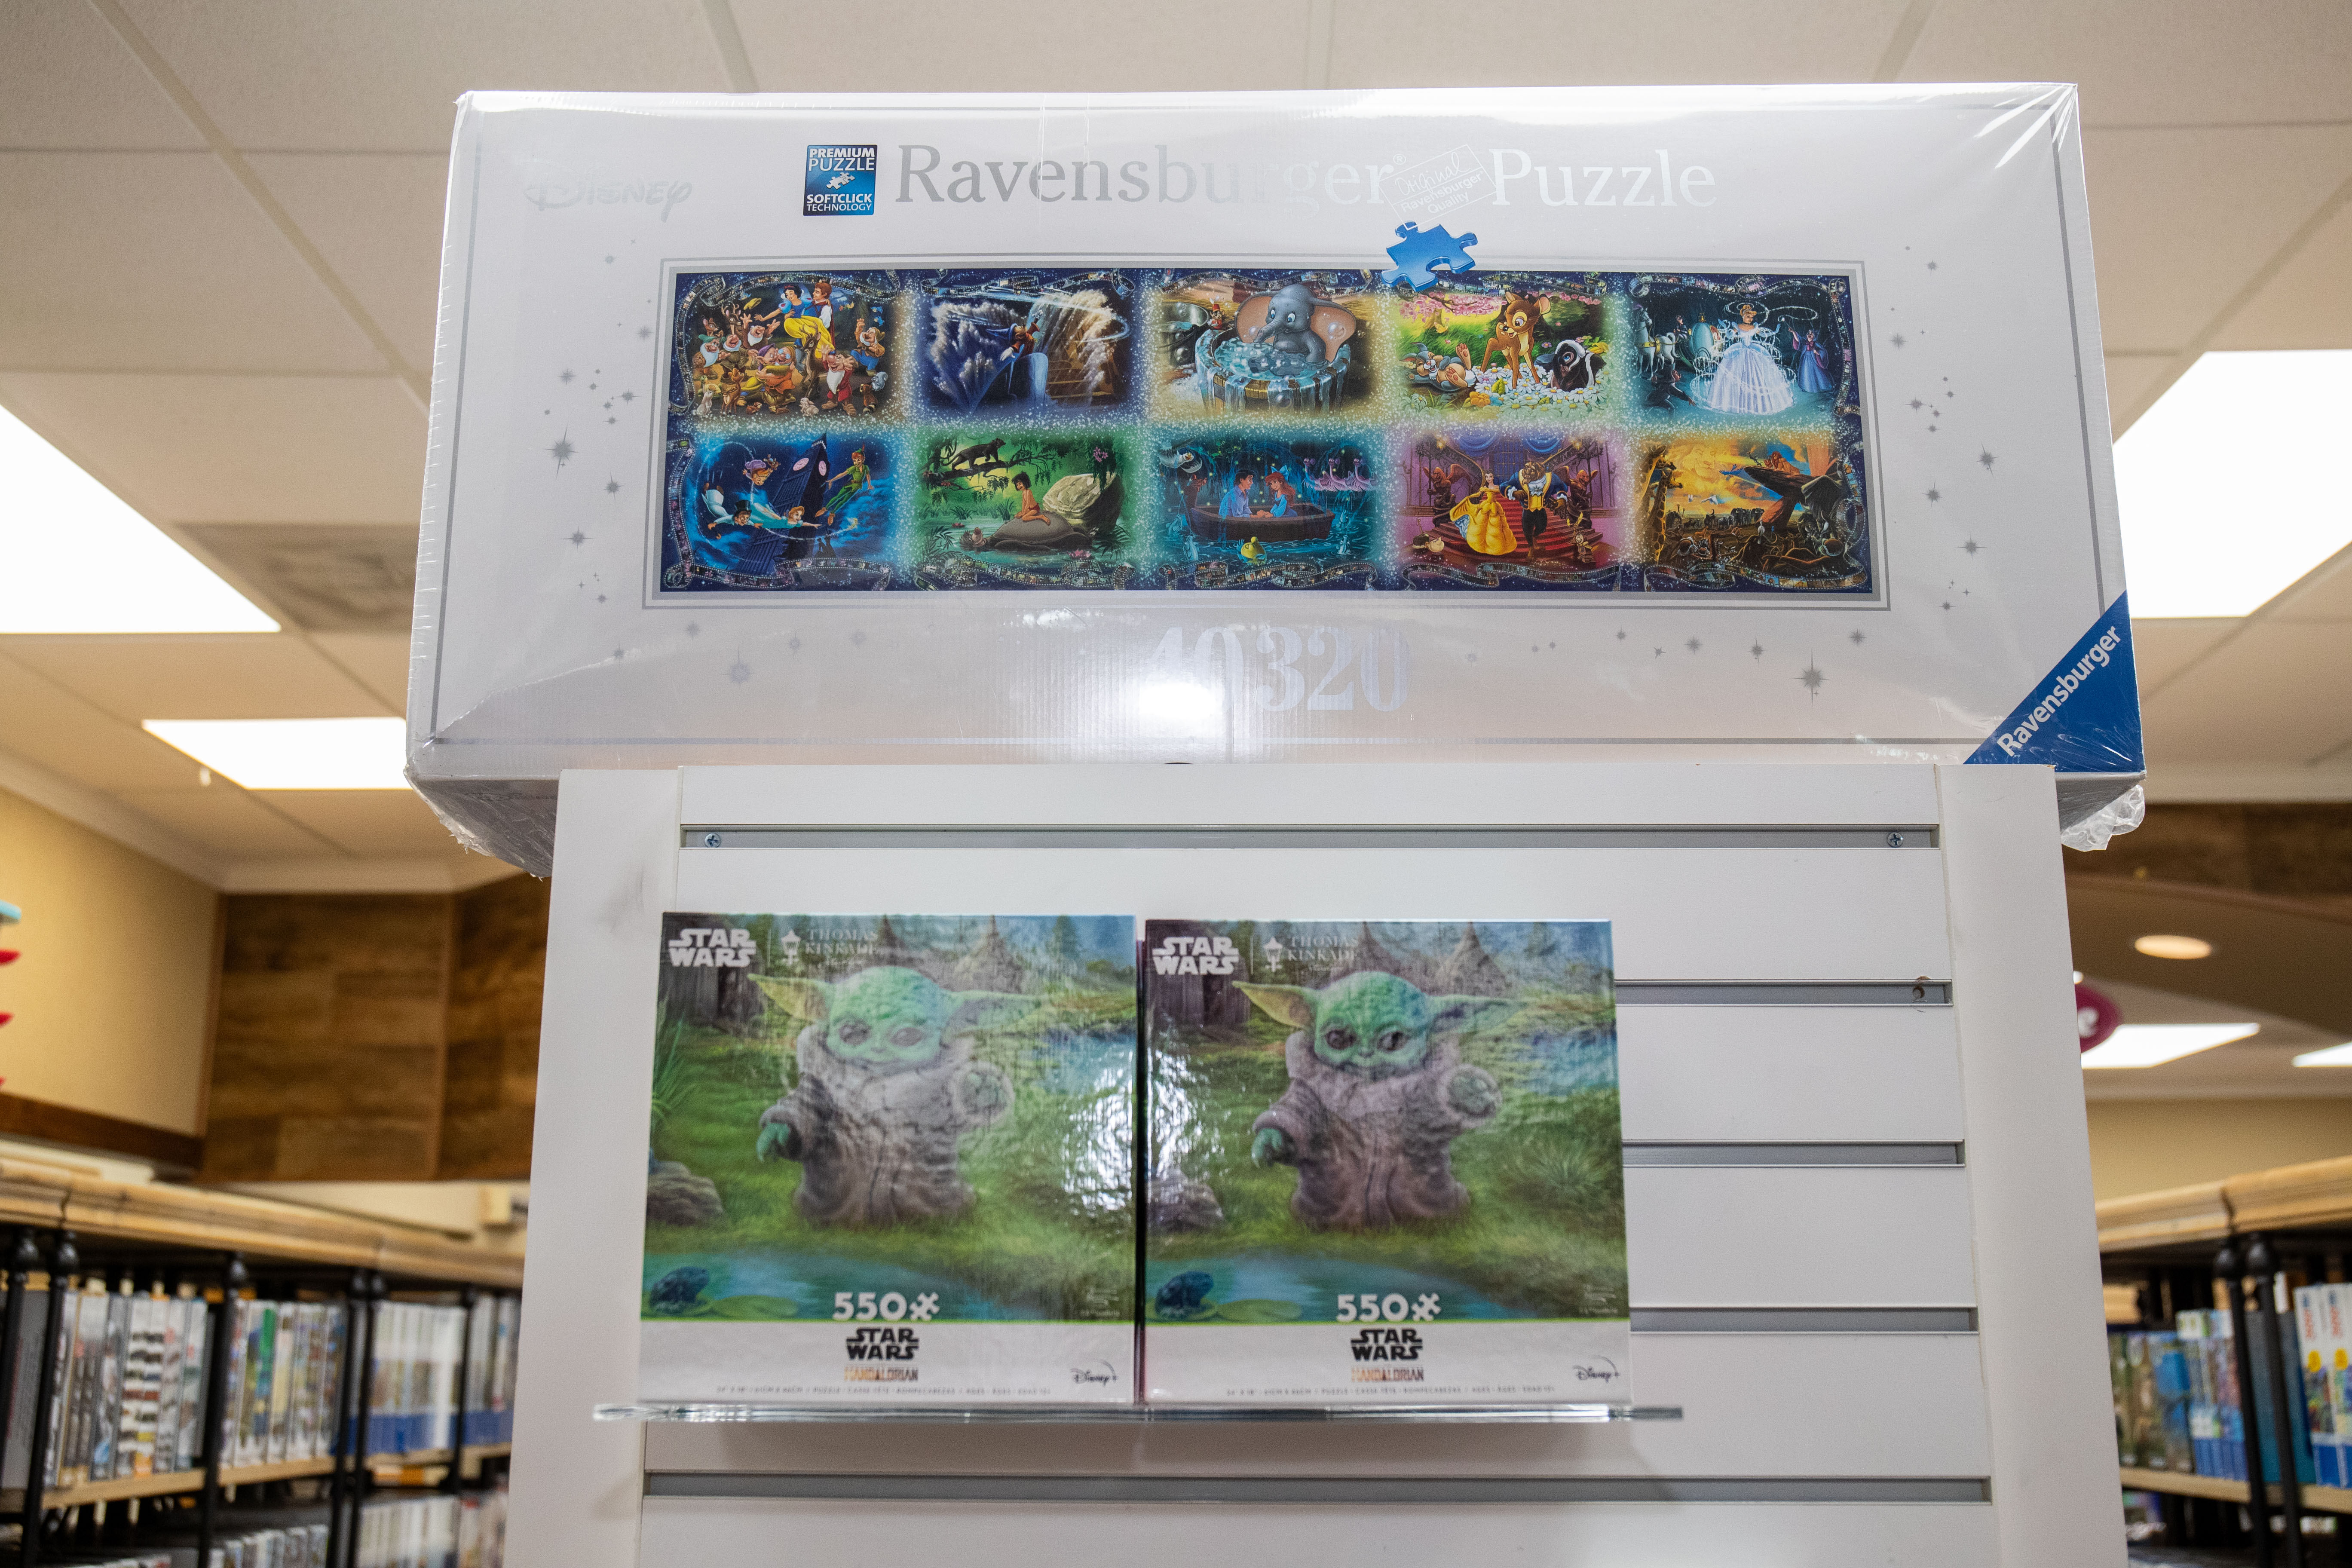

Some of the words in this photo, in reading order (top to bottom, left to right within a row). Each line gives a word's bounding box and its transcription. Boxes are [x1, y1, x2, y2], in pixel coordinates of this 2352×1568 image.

[810, 148, 875, 158] PREMIUM
[808, 157, 875, 171] PUZZLE
[1488, 149, 1718, 207] Puzzle
[806, 203, 872, 211] TECHNOLOGY
[807, 193, 872, 204] SOFTCLICK
[1427, 191, 1469, 214] Quality
[1997, 625, 2121, 757] Ravensburger
[668, 928, 756, 947] STAR
[1152, 937, 1240, 956] STAR
[668, 948, 756, 967] WARS
[1152, 956, 1240, 975] WARS
[832, 1291, 907, 1321] 550
[1336, 1292, 1409, 1322] 550
[845, 1327, 919, 1342] STAR
[1351, 1328, 1423, 1343] STAR
[846, 1345, 919, 1360] WARS
[1351, 1345, 1423, 1361] WARS
